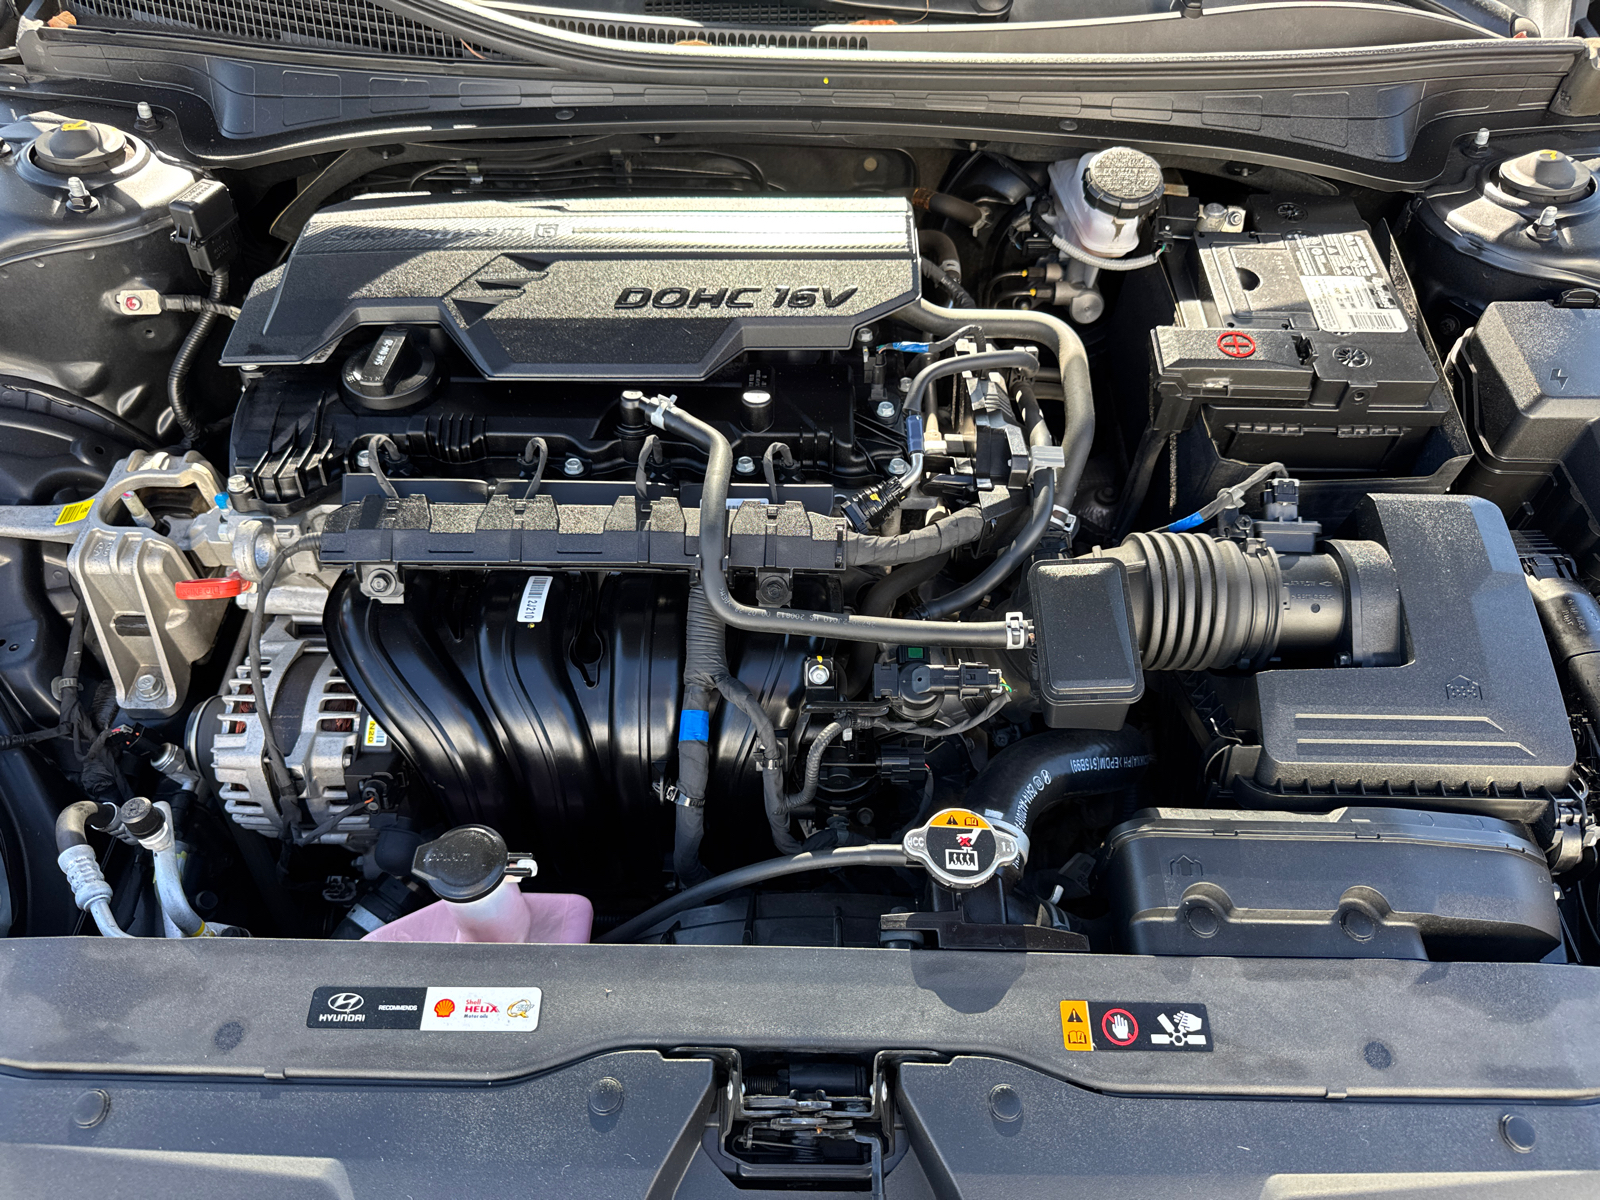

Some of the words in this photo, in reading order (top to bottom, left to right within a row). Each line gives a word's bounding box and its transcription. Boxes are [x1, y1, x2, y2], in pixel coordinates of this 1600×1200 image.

[613, 286, 762, 310] DOHC
[771, 285, 859, 309] 16V
[524, 599, 538, 619] 2J210
[368, 721, 376, 743] N20
[1001, 841, 1015, 852] 1.1
[464, 1004, 499, 1013] HELIX
[318, 1013, 366, 1022] HYUNDAI
